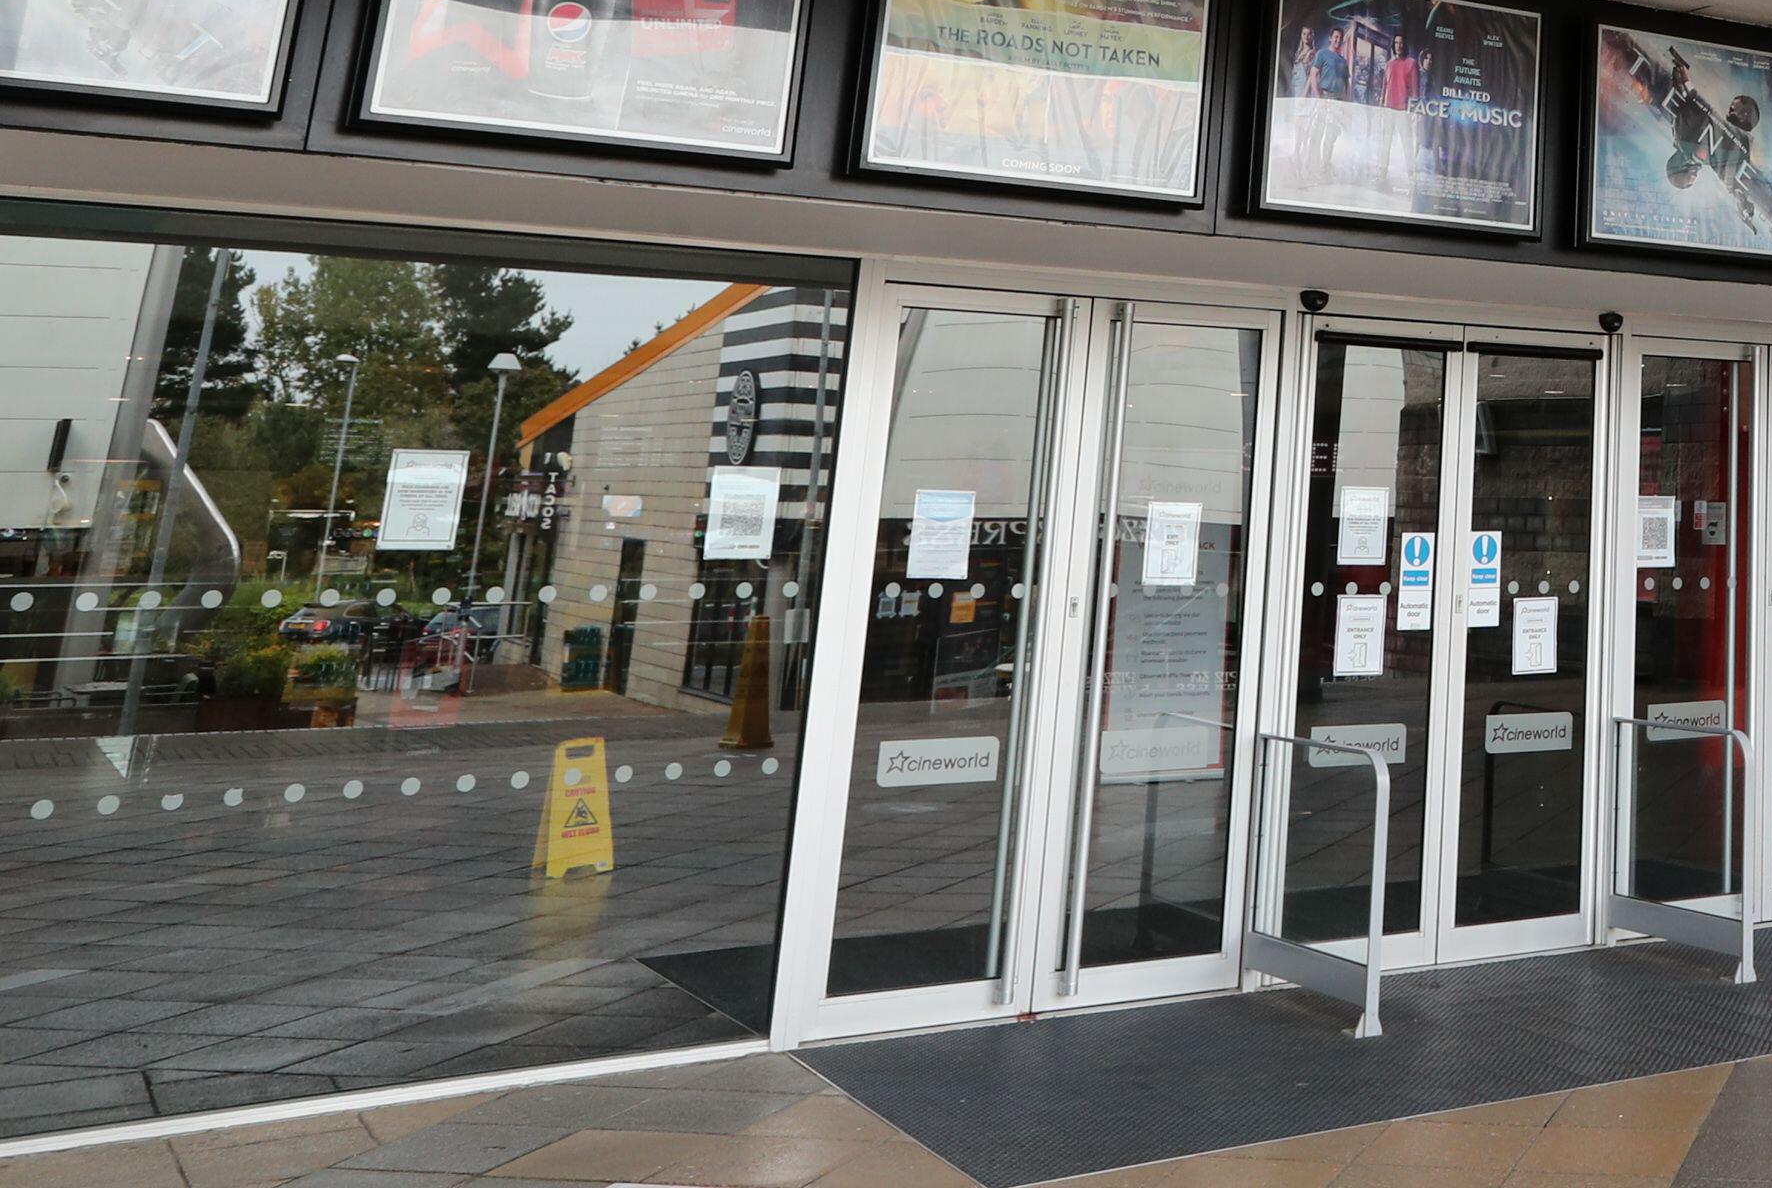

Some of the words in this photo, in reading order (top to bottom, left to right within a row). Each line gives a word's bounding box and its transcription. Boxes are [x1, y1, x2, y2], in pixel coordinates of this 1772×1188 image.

[937, 25, 970, 44] THE
[976, 29, 1045, 53] ROADS
[1052, 40, 1093, 60] NOT
[1099, 45, 1160, 68] TAKEN
[1462, 57, 1476, 66] THE
[1454, 66, 1481, 76] FUTURE
[1453, 75, 1482, 87] AWAITS
[1442, 86, 1465, 99] BILL
[1470, 90, 1491, 103] TED
[1407, 97, 1451, 119] FACE
[1461, 105, 1522, 128] MUSIC
[721, 124, 772, 137] cineworld
[1002, 158, 1048, 173] COMING
[1048, 160, 1081, 175] SOON
[1507, 724, 1567, 742] cineworld
[1126, 742, 1199, 760] cineworld
[906, 751, 990, 772] cineworld
